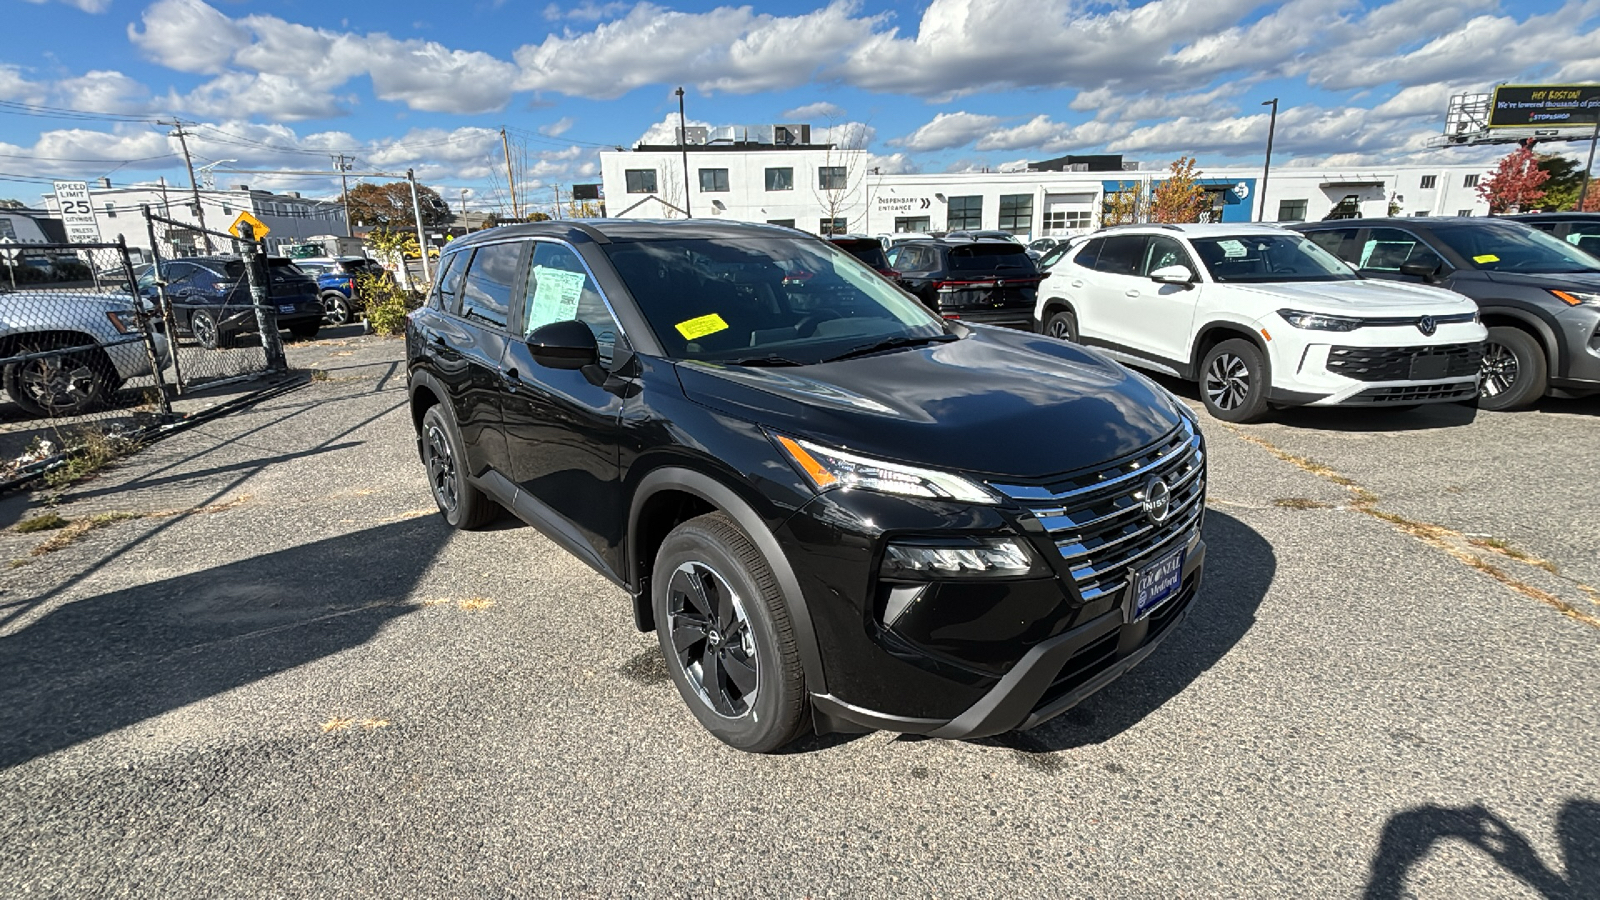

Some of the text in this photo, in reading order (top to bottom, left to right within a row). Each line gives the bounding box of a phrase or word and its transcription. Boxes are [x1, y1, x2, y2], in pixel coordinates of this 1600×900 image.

[1497, 101, 1517, 109] We're
[1545, 100, 1579, 108] thousands
[1580, 100, 1588, 108] of
[61, 201, 90, 213] 25
[1150, 572, 1178, 598] Medford
